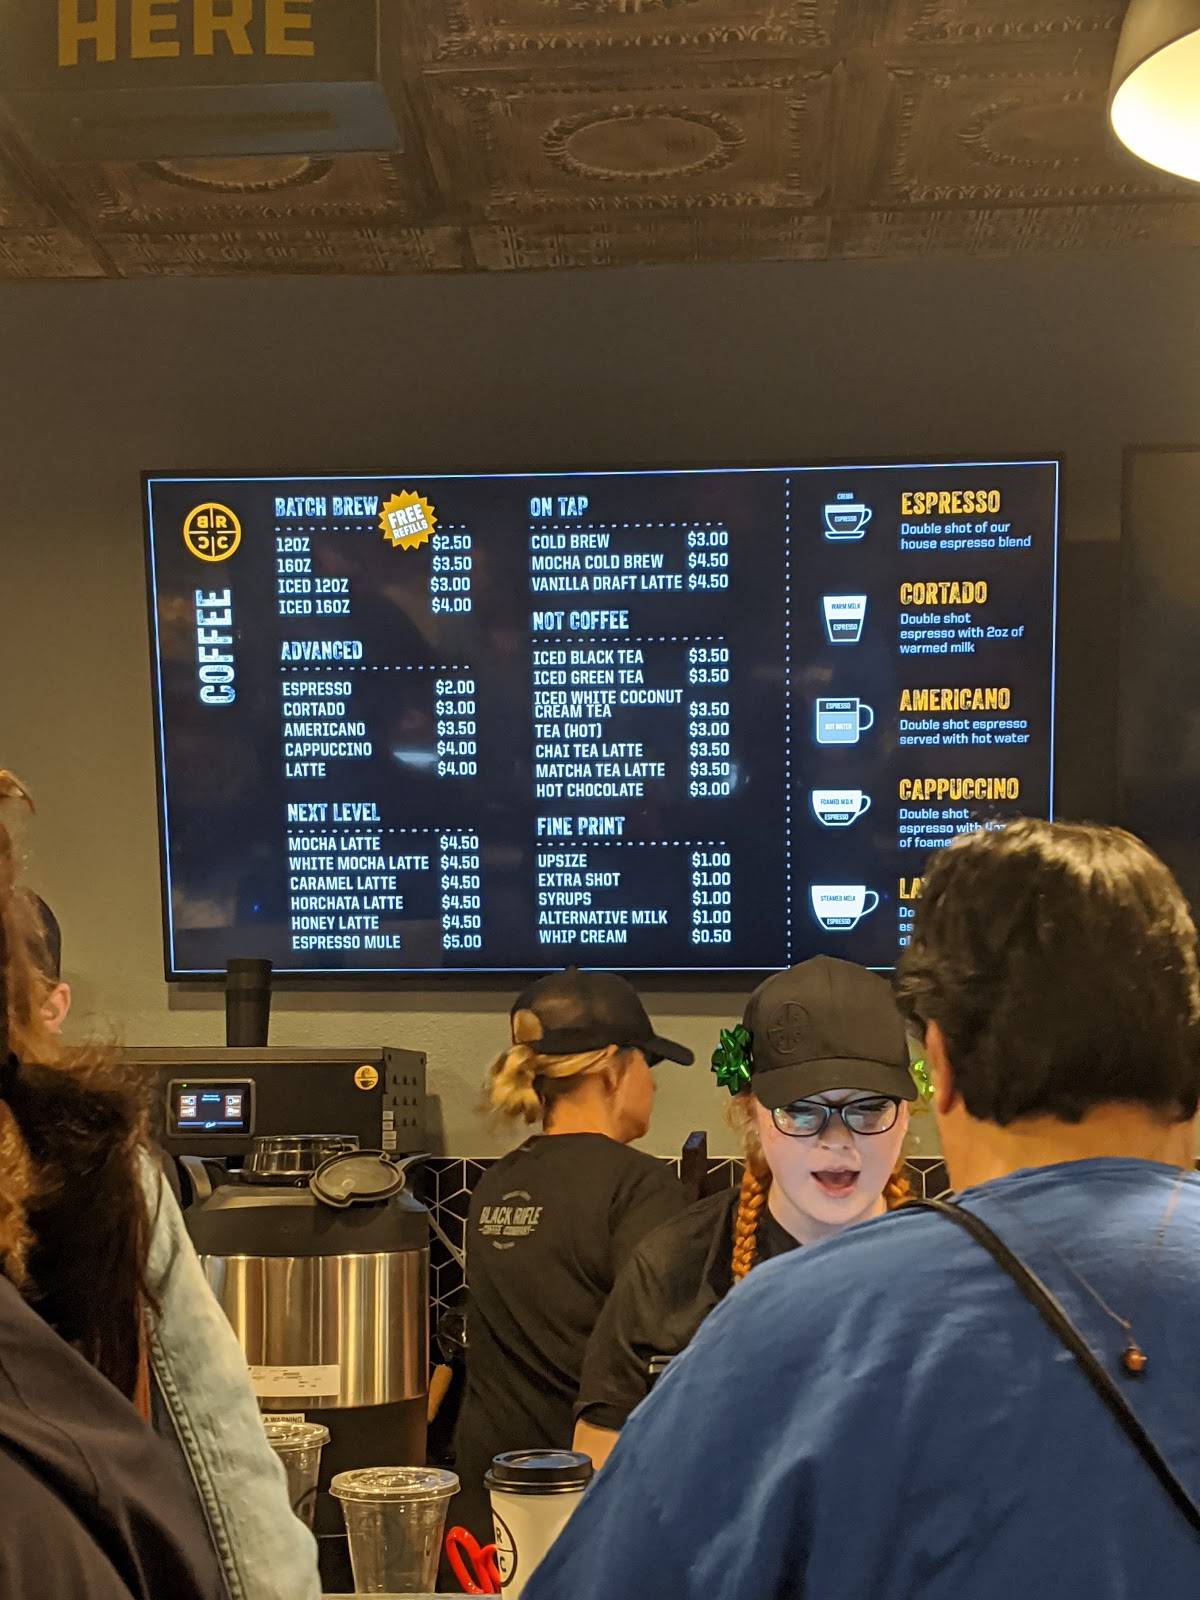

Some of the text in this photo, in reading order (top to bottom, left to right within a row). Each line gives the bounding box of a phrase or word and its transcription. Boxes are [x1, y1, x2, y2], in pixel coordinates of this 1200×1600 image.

[58, 0, 315, 67] HERE
[275, 496, 378, 517] BATCH BREW
[531, 497, 588, 517] ON TAP
[901, 490, 1000, 515] ESPRESSO
[388, 503, 424, 529] FREE
[393, 519, 428, 539] REFILLS
[901, 522, 1010, 534] Double shot of our
[432, 536, 471, 551] $2.50
[532, 531, 728, 549] COLD BREW $3.00
[901, 536, 1031, 550] house espresso blend
[432, 557, 472, 572] $3.50
[532, 553, 728, 570] MOCHA COLD BREW $4.50
[278, 579, 311, 593] ICED
[431, 578, 470, 592] $3.00
[532, 573, 728, 591] VANILLA DRAFT LATTE $4.50
[901, 582, 987, 604] CORTADO
[279, 600, 312, 614] ICED
[432, 599, 471, 613] $4.00
[533, 611, 629, 630] NOT COFFEE
[901, 613, 971, 624] Double shot
[900, 626, 1024, 640] espresso with 2oz of
[195, 589, 236, 704] COFFEE
[281, 641, 362, 660] ADVANCED
[900, 642, 975, 653] warmed milk
[534, 648, 729, 665] ICED BLACK TEA $3.50
[534, 668, 729, 685] ICED GREEN TEA $3.50
[283, 680, 475, 696] ESPRESSO $2.00
[535, 689, 683, 705] ICED WHITE COCONUT
[900, 688, 1010, 711] AMERICANO
[283, 701, 475, 716] CORTADO $3.00
[535, 702, 729, 718] CREAM TEA $3.50
[284, 721, 476, 736] AMERICANO $3.50
[535, 724, 560, 738] TEA
[689, 722, 729, 737] $3.00
[900, 719, 1027, 730] Double shot espresso
[900, 733, 1030, 744] served with hot water
[285, 742, 476, 756] CAPPUCCINO $4.00
[536, 742, 729, 758] CHAI TEA LATTE $3.50
[286, 762, 477, 777] LATTE $4.00
[536, 762, 729, 777] MATCHA TEA LATTE $3.50
[537, 781, 729, 797] HOT CHOCOLATE $3.00
[899, 778, 1019, 800] CAPPUCCINO
[288, 803, 380, 821] NEXT LEVEL
[899, 808, 969, 819] Double shot
[537, 817, 625, 836] FINE PRINT
[900, 823, 953, 835] espresso
[289, 835, 479, 851] MOCHA LATTE $4.50
[900, 837, 952, 848] of foame
[289, 855, 479, 870] WHITE MOCHA LATTE $4.50
[538, 852, 730, 868] UPSIZE $1.00
[291, 875, 480, 890] CARAMEL LATTE $4.50
[538, 871, 730, 887] EXTRA SHOT $1.00
[291, 895, 480, 910] HORCHATA LATTE $4.50
[539, 891, 731, 906] SYRUPS $1.00
[292, 914, 481, 930] HONEY LATTE $4.50
[539, 910, 731, 925] ALTERNATIVE MILK $1.00
[292, 934, 481, 949] ESPRESSO MULE $5.00
[539, 929, 731, 944] WHIP CREAM $0.50
[479, 1207, 543, 1224] BLACK RIFLE
